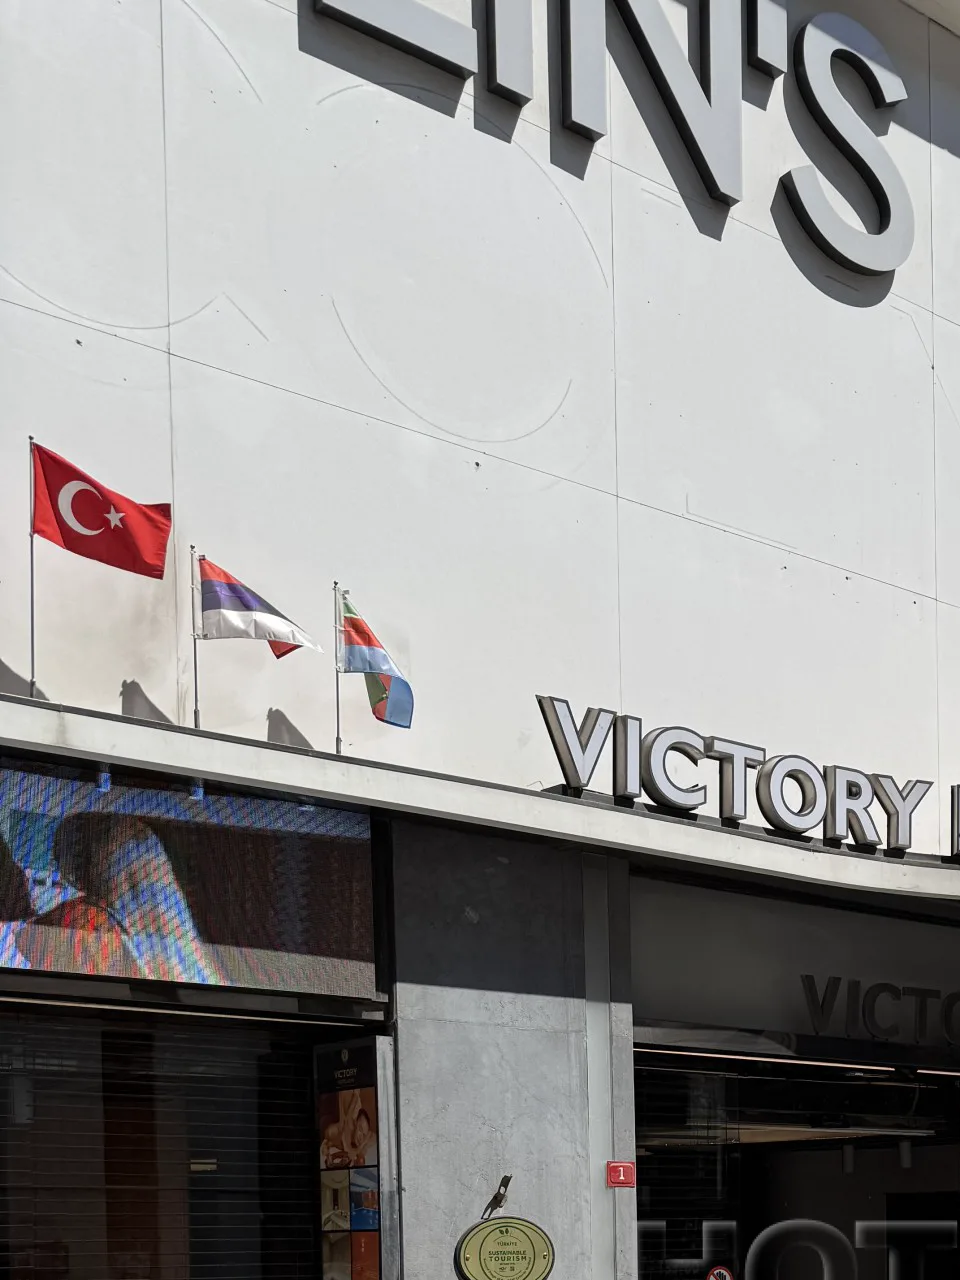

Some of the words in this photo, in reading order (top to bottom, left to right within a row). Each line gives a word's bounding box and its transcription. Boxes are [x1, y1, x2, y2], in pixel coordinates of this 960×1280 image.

[303, 0, 915, 276] N'S
[535, 695, 933, 851] VICTORY
[618, 1167, 625, 1180] 1
